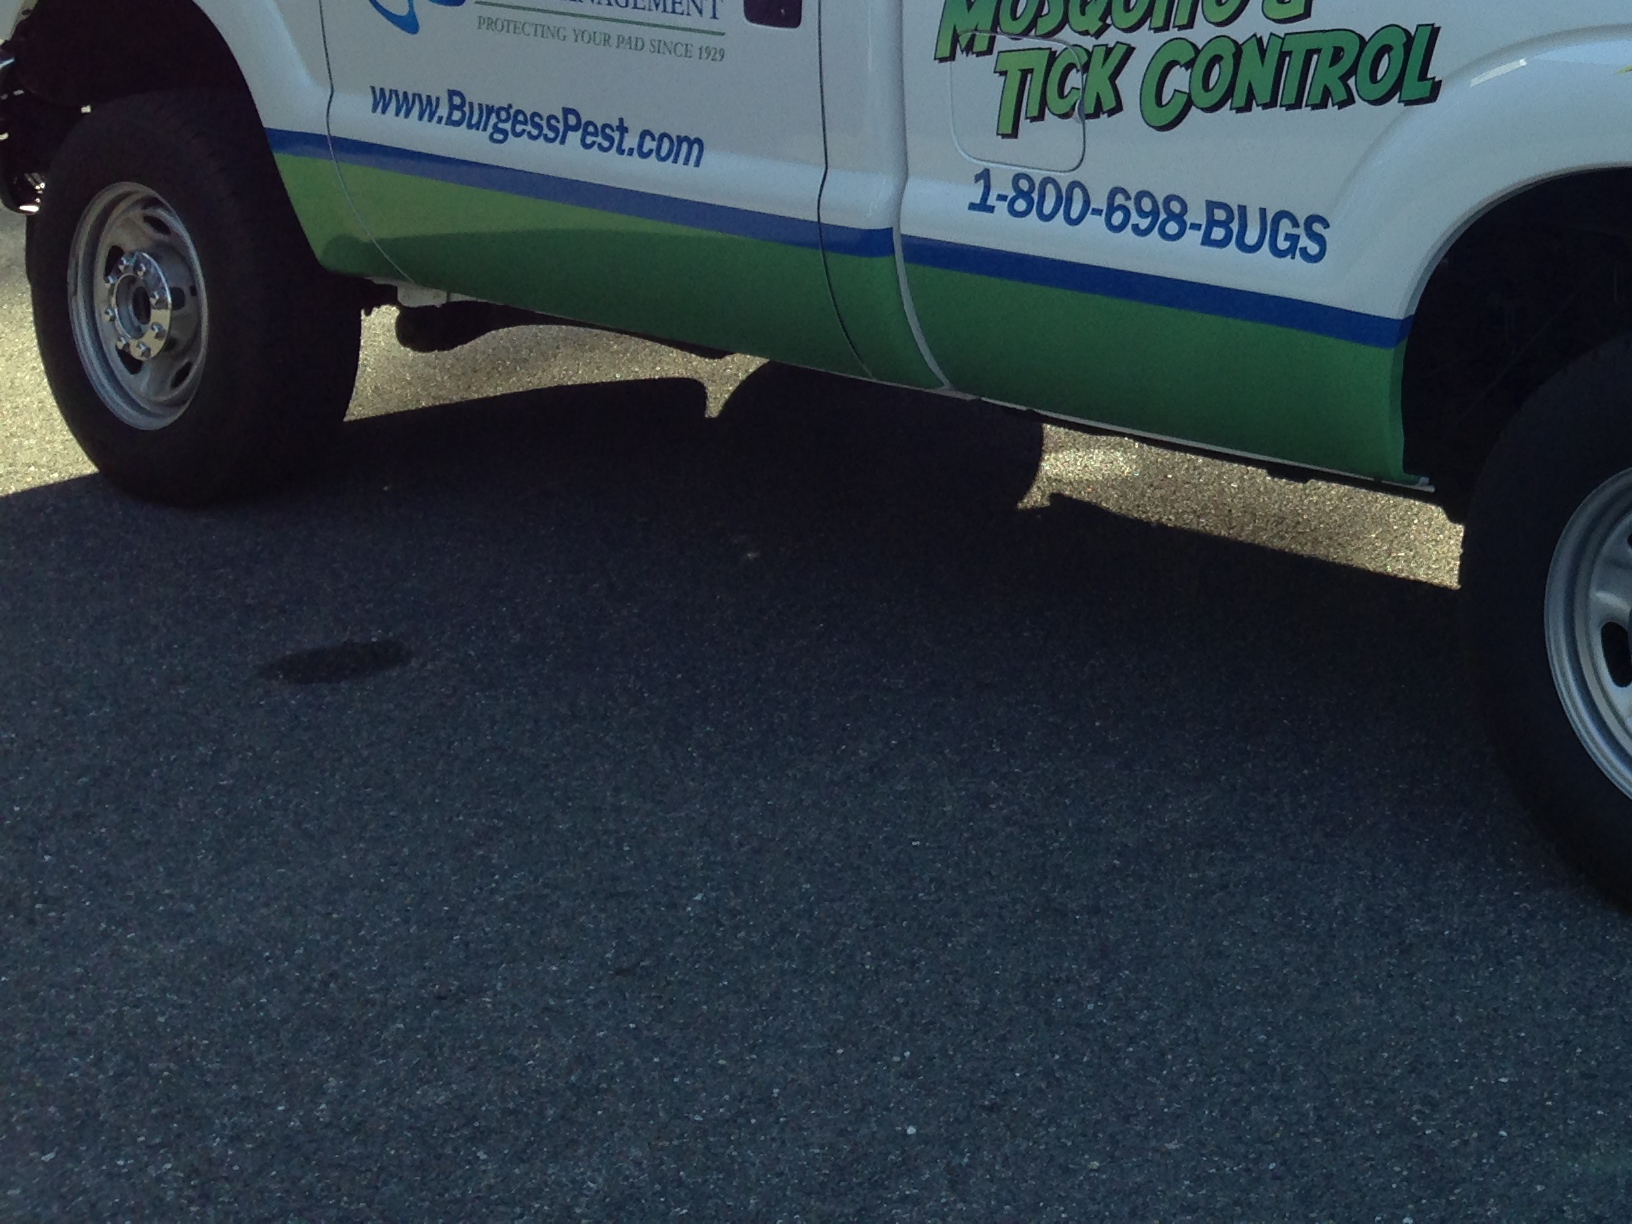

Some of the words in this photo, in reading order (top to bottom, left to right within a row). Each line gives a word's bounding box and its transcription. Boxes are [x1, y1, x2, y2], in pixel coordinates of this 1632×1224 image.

[477, 15, 567, 42] PROTECTING
[573, 28, 611, 48] YOUR
[615, 34, 645, 51] PAD
[649, 39, 693, 59] SINCE
[698, 45, 726, 62] 1929
[993, 41, 1136, 139] TICK
[1139, 23, 1442, 132] CONTROL
[369, 85, 705, 168] www.BurgessPest.com
[967, 168, 1330, 264] 1-800-698-BUGS
